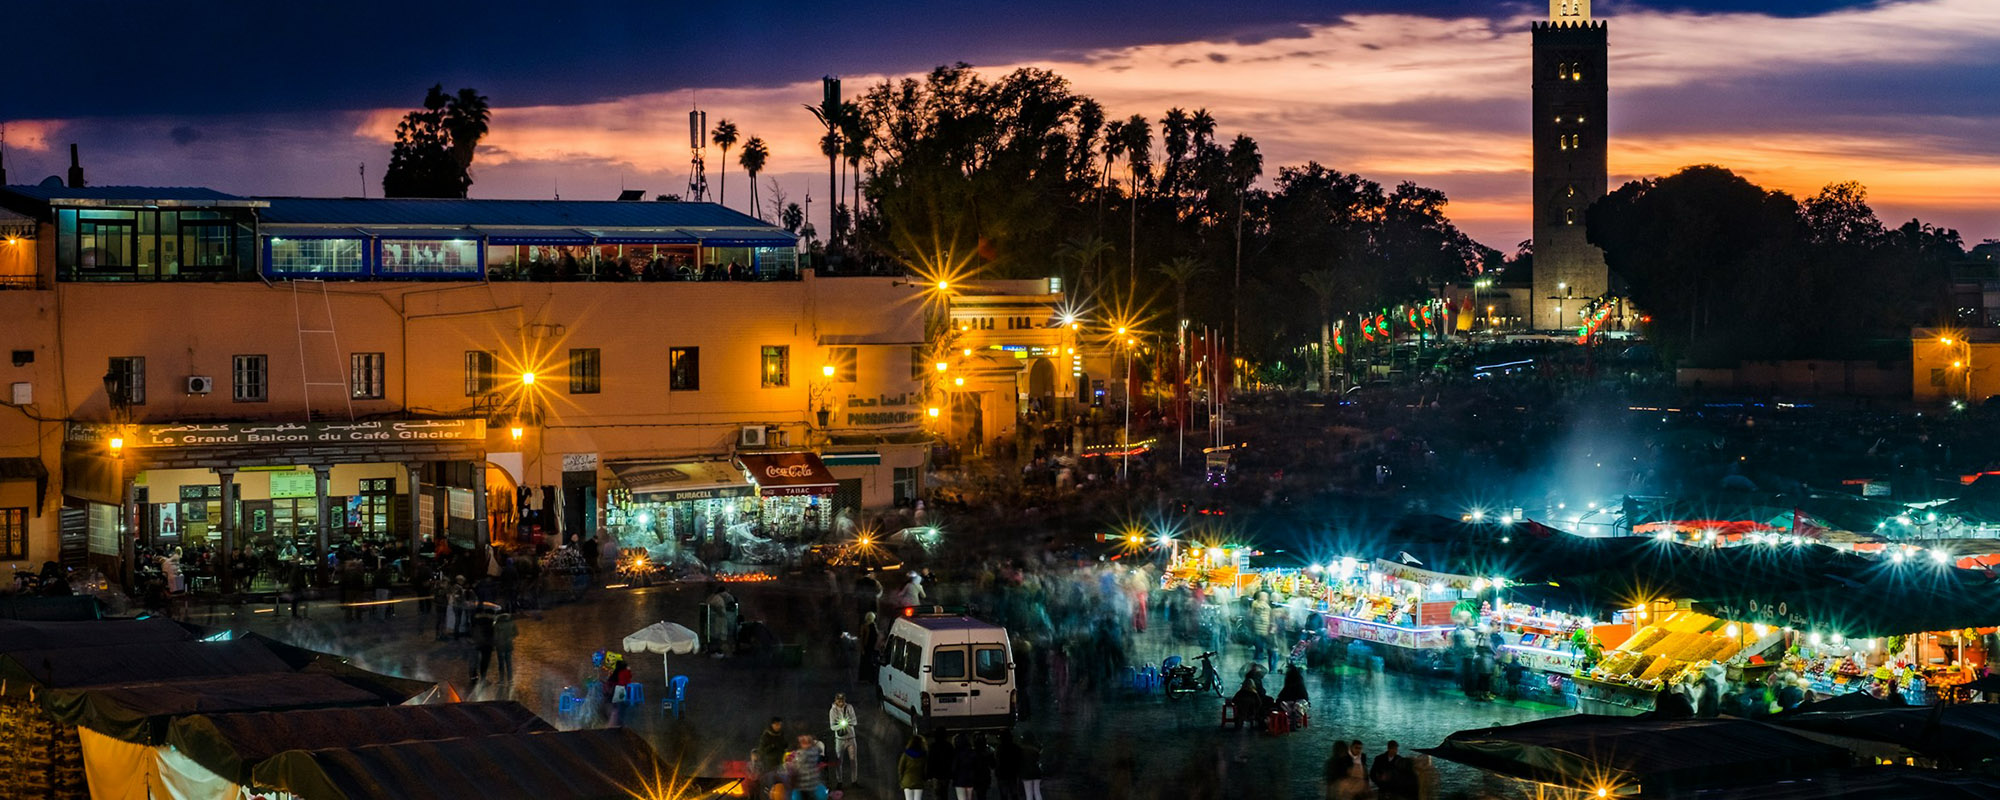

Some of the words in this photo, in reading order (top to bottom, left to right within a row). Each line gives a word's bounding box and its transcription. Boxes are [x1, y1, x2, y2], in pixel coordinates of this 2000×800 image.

[847, 411, 907, 425] PHARMACIE
[152, 436, 174, 444] Le
[183, 434, 238, 443] Grand
[247, 433, 309, 442] Balcon
[318, 431, 341, 440] du
[350, 430, 390, 440] Café
[398, 429, 462, 439] Glacier
[623, 470, 682, 484] DURACELL
[766, 464, 814, 478] Coca-Cola
[676, 491, 712, 500] DURACELL
[1760, 603, 1774, 619] 45
